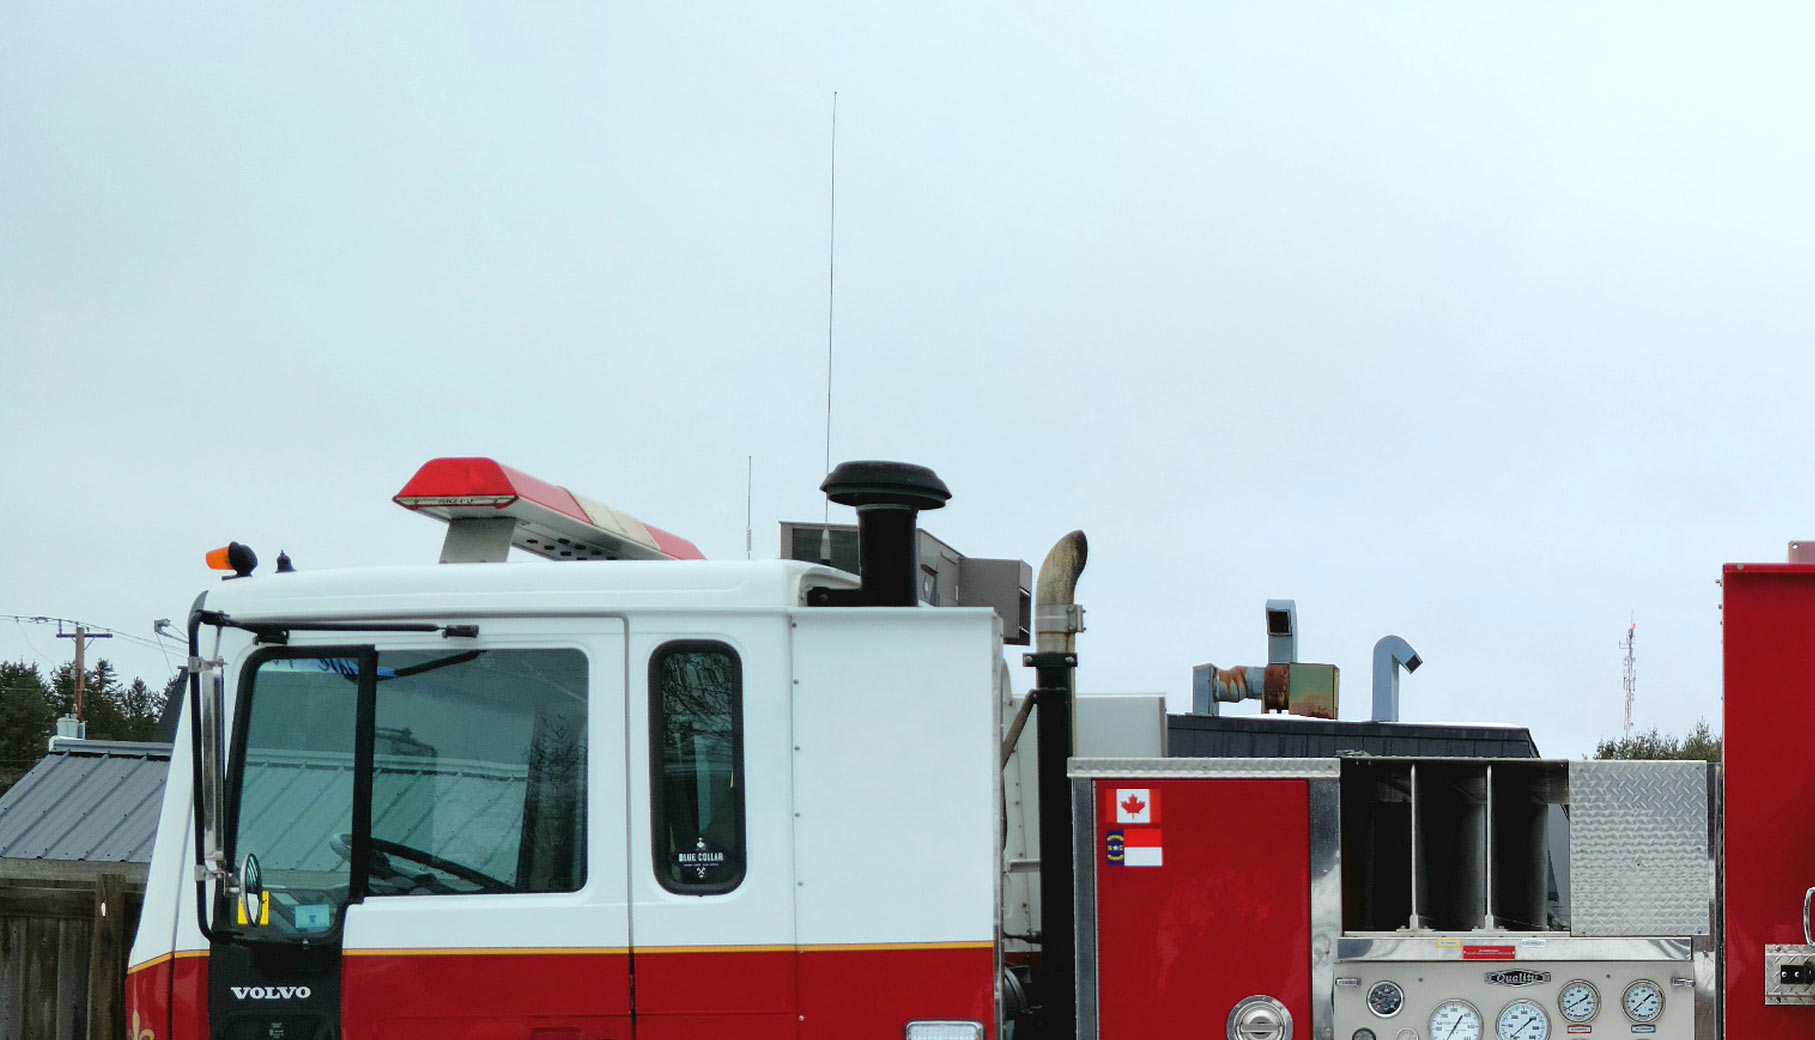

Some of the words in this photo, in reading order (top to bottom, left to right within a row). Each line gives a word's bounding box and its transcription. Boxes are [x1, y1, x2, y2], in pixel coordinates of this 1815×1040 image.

[678, 853, 697, 862] BLUE
[698, 852, 723, 862] COLLAR
[230, 986, 312, 1000] VOLVO
